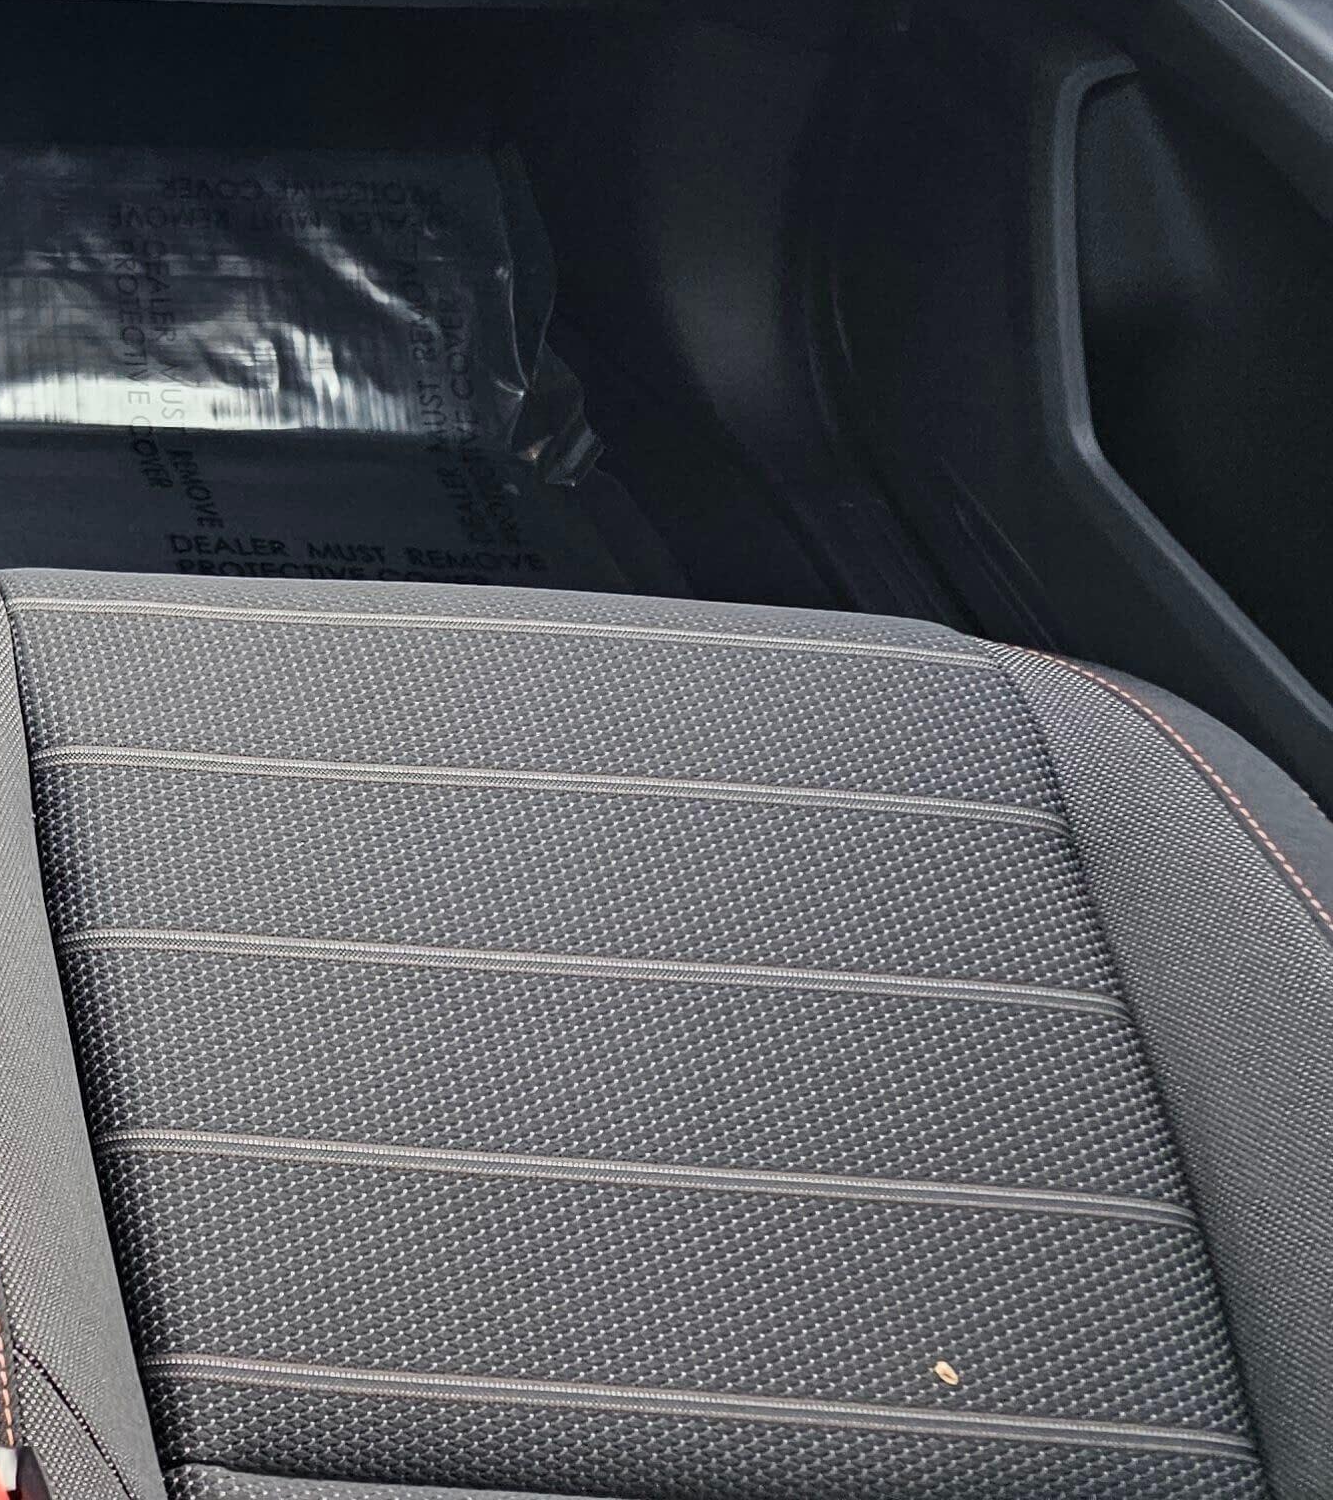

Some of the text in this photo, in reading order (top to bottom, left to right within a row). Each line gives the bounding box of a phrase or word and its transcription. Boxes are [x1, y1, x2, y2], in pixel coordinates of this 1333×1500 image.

[166, 533, 549, 573] DEALER MUST REMOVE
